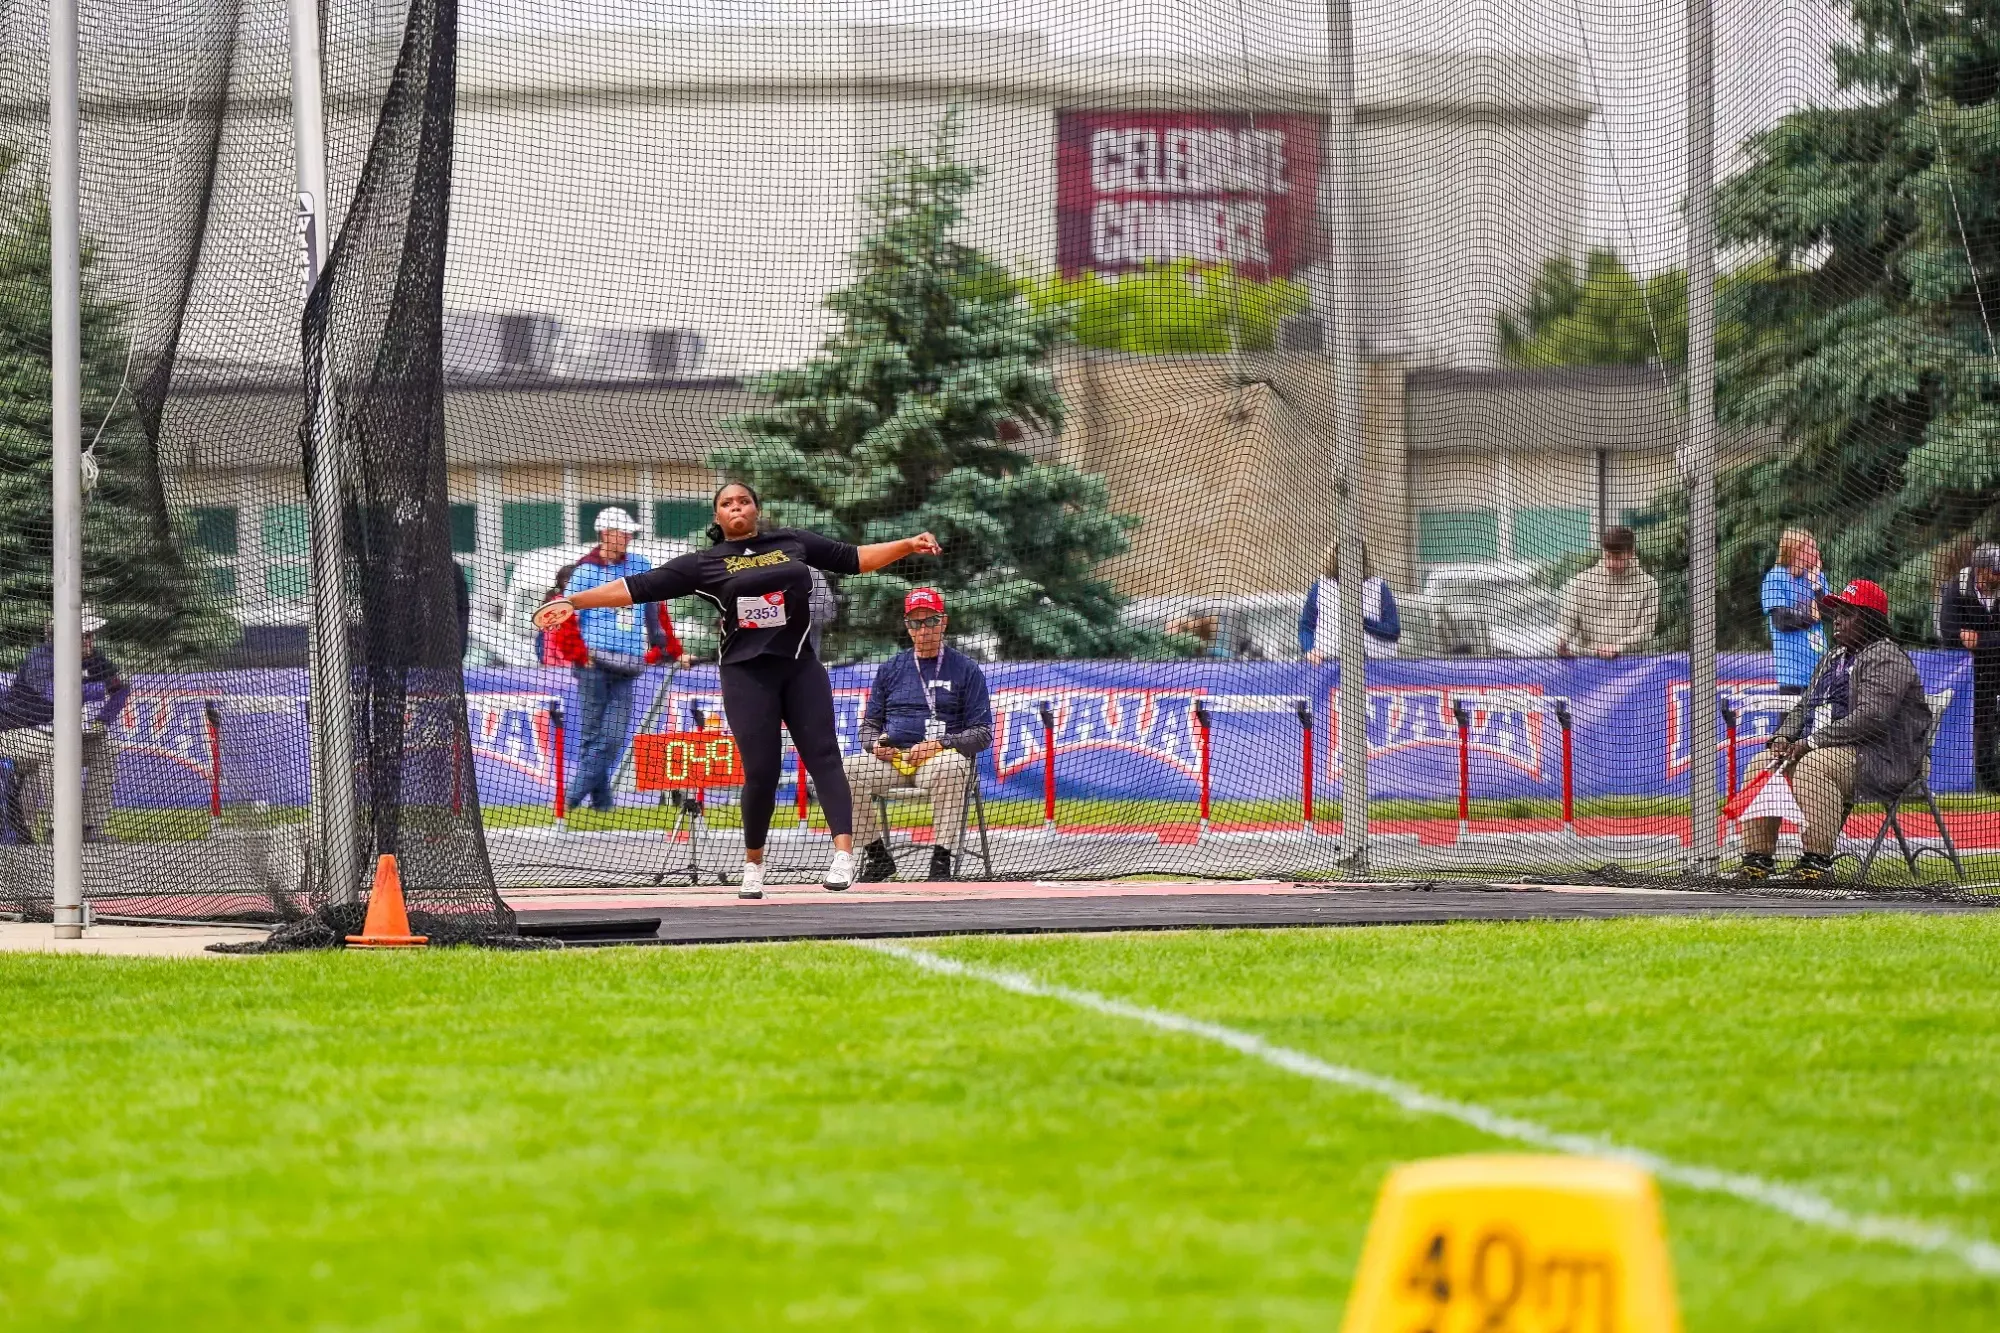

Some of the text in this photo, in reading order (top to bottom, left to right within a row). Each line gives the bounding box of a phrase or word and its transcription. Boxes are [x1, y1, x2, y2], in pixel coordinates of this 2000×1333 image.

[1091, 128, 1290, 191] CELEBRATE
[723, 549, 787, 569] XAVIER
[744, 605, 778, 620] 2353
[996, 689, 1205, 780] NAIA
[1405, 1228, 1613, 1309] 40m
